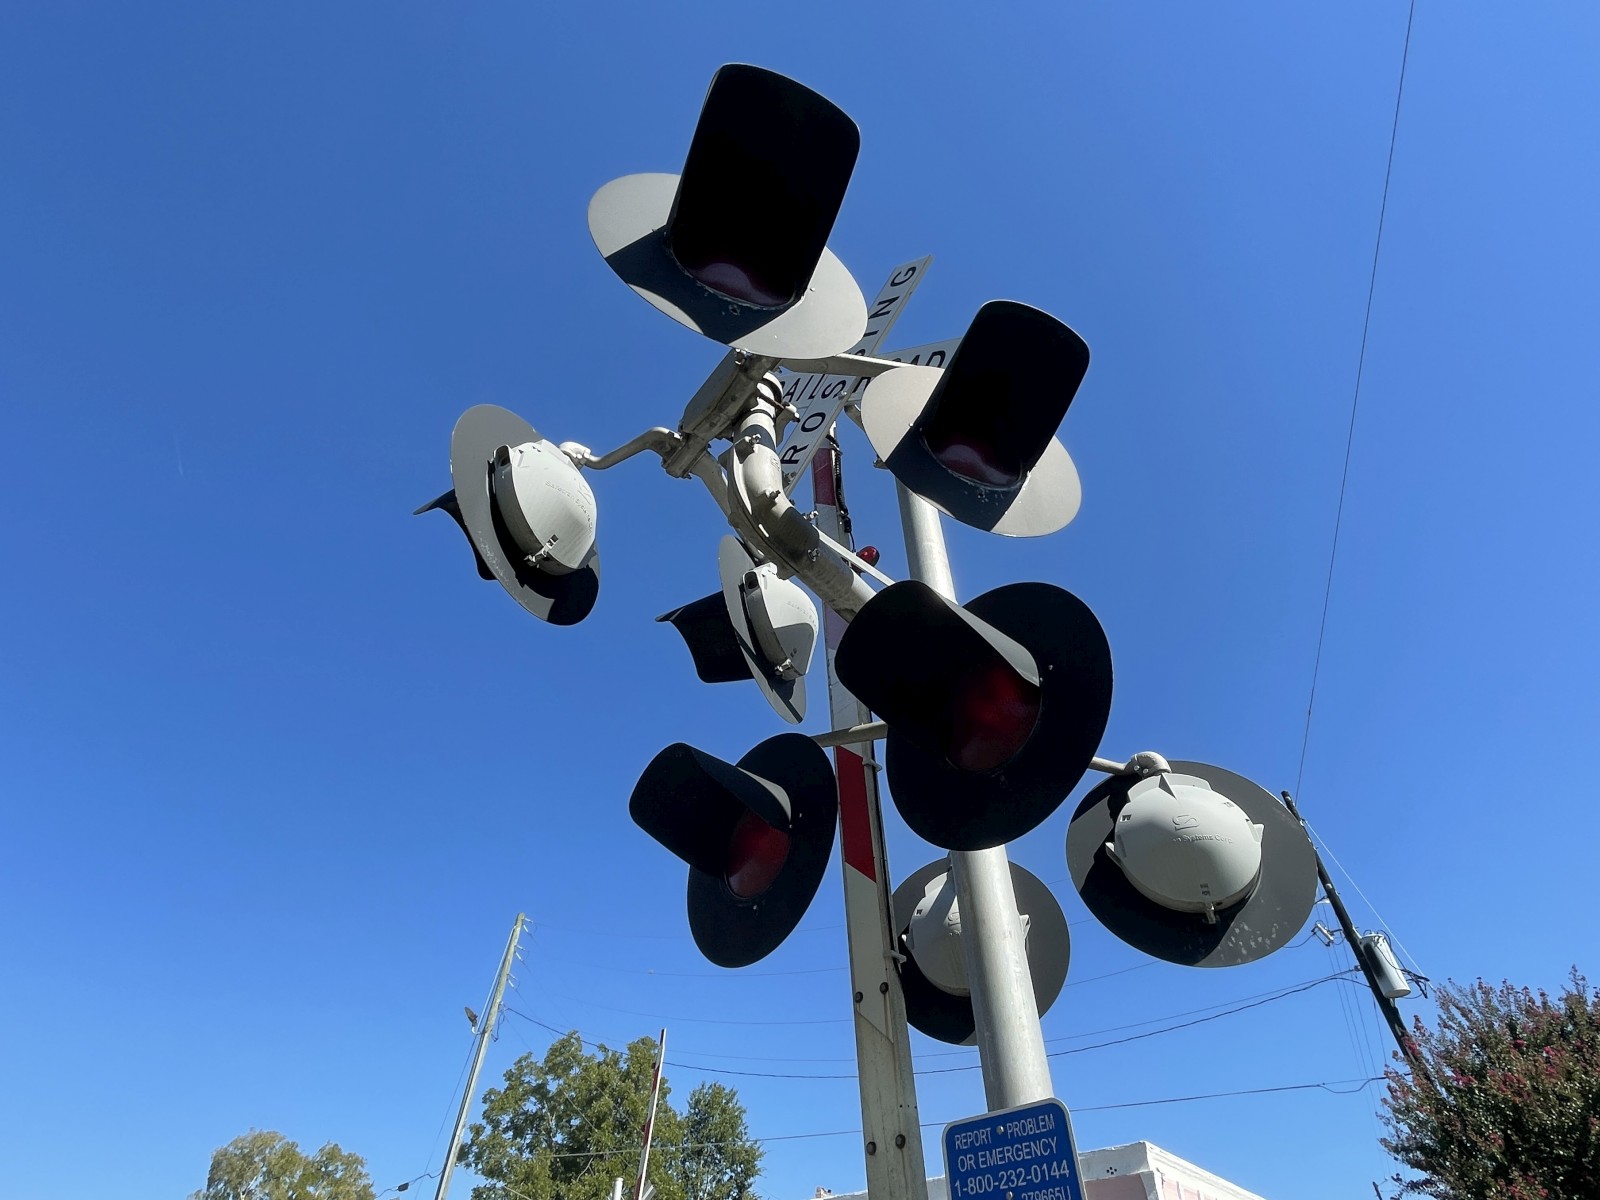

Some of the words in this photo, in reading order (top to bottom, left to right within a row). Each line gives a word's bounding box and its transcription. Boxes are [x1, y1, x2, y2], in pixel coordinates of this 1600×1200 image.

[955, 1127, 992, 1150] REPORT
[1007, 1113, 1055, 1139] PROBLEM
[958, 1156, 976, 1172] OR
[979, 1136, 1057, 1167] EMERGENCY
[955, 1159, 1070, 1198] 1-800-232-0144
